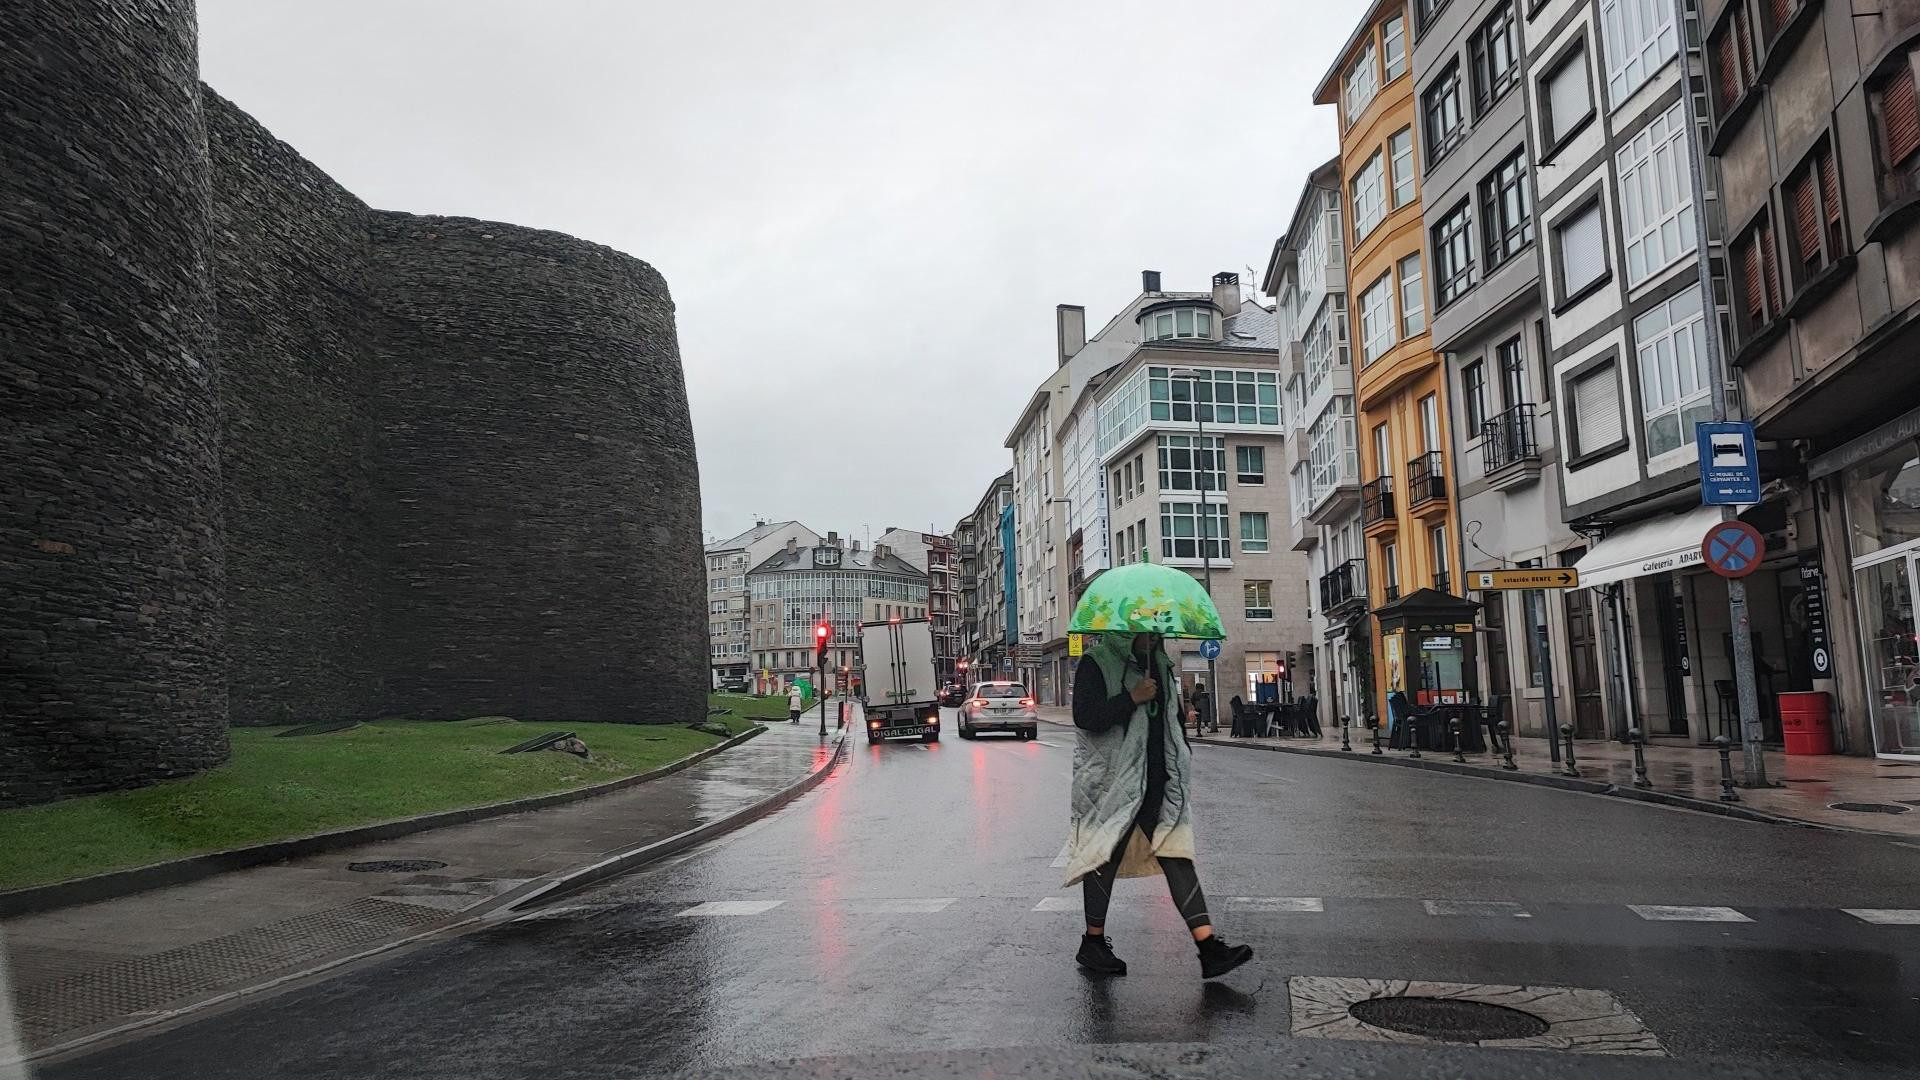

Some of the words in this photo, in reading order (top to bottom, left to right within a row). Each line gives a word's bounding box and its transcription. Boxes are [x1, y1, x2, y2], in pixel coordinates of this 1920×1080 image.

[1679, 551, 1703, 564] ADARV
[873, 729, 902, 738] DIGAL
[907, 727, 937, 736] DIGAL
